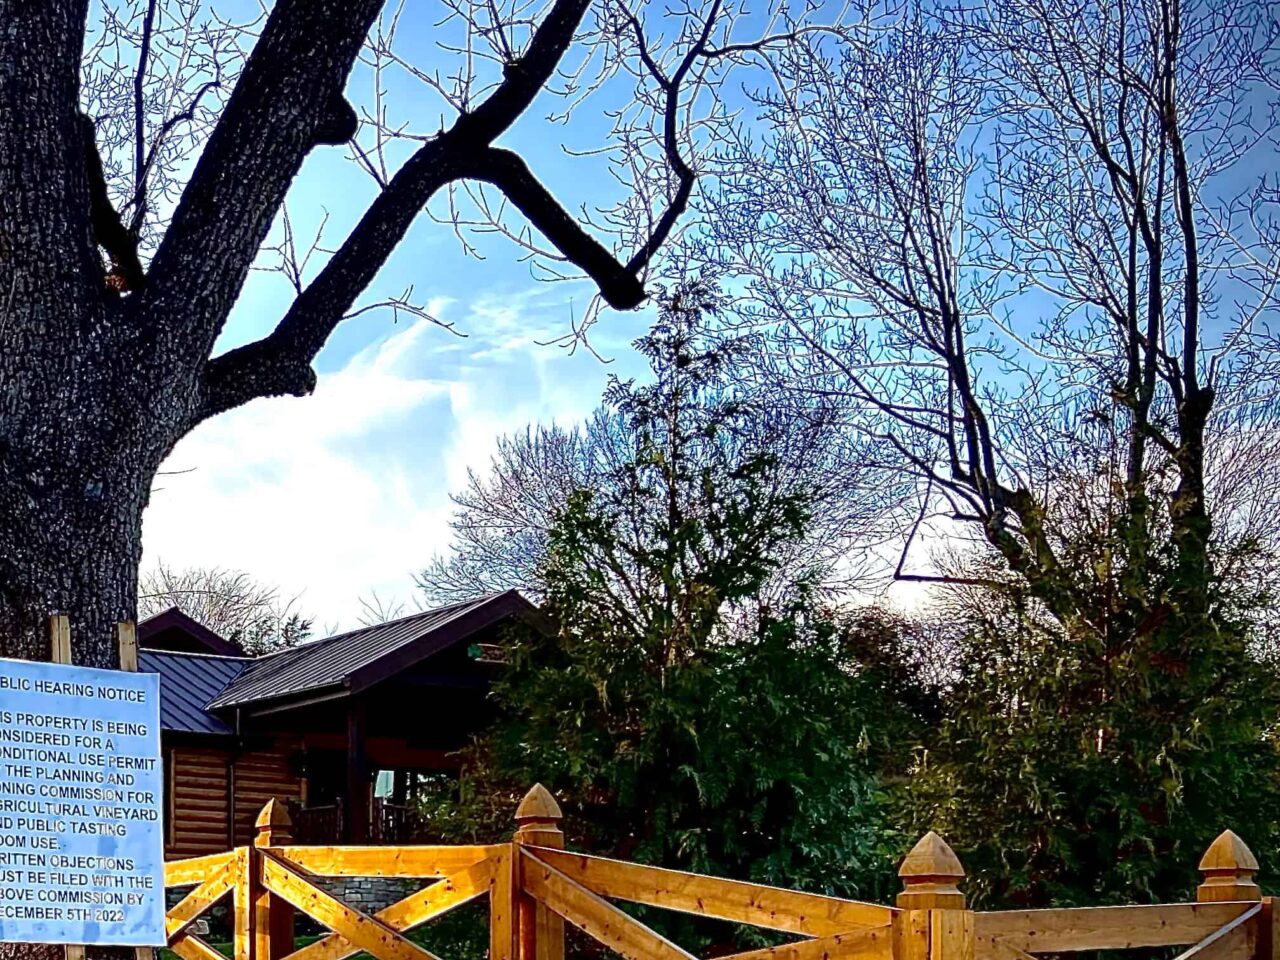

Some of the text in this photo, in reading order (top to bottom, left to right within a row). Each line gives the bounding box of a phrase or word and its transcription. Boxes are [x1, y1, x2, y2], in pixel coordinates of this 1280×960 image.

[35, 680, 93, 697] HEARING
[98, 687, 145, 702] NOTICE
[17, 713, 88, 731] PROPERTY
[92, 720, 103, 732] IS
[108, 722, 147, 736] BEING
[75, 736, 101, 749] FOR
[105, 739, 114, 750] A
[79, 754, 104, 766] USE
[109, 756, 156, 770] PERMIT
[5, 765, 32, 777] THE
[36, 768, 103, 782] PLANNING
[107, 773, 134, 785] AND
[40, 786, 123, 802] COMMISSION
[128, 792, 154, 804] FOR
[93, 806, 158, 821] VINEYARD
[18, 818, 66, 832] PUBLIC
[71, 822, 126, 836] TASTING
[31, 837, 61, 849] USE.
[50, 855, 134, 870] OBJECTIONS
[28, 871, 46, 884] BE
[50, 872, 88, 886] FILED
[92, 875, 123, 888] WITH
[127, 876, 153, 889] THE
[38, 890, 123, 904] COMMISSION
[127, 893, 144, 905] BY
[67, 908, 91, 920] 5TH
[96, 910, 123, 921] 2022
